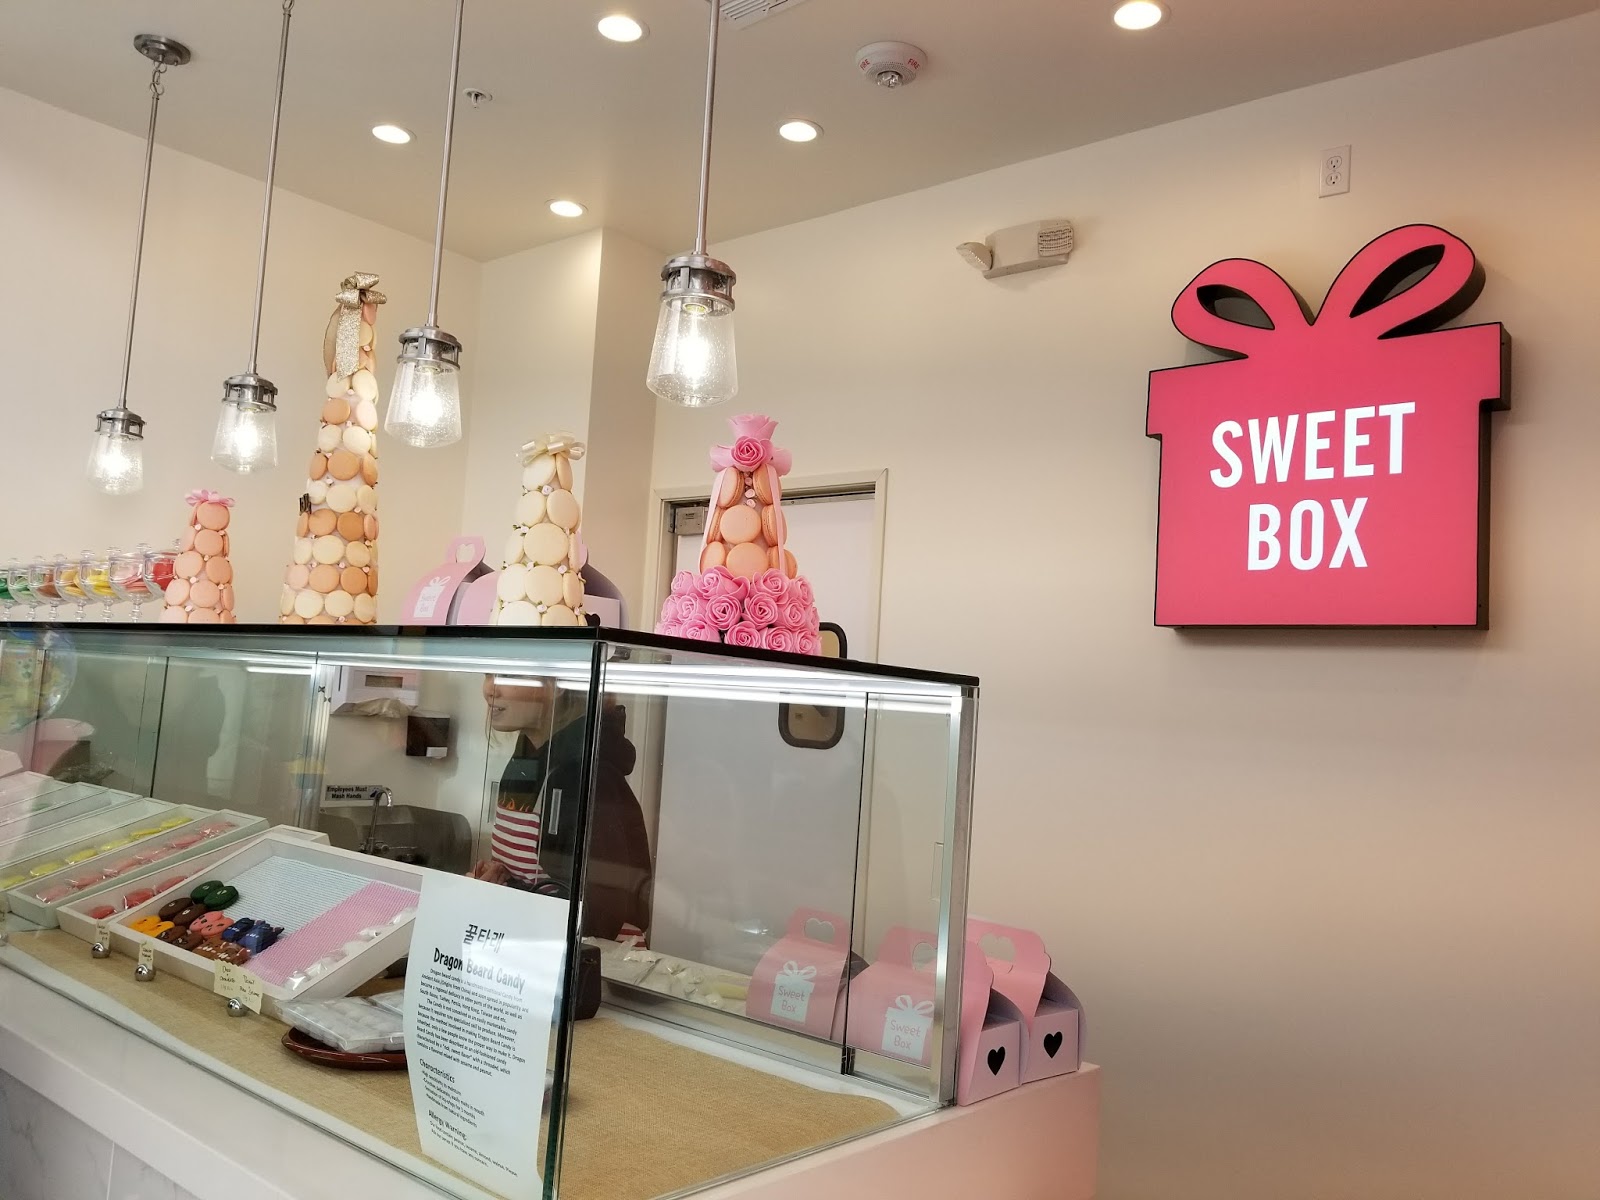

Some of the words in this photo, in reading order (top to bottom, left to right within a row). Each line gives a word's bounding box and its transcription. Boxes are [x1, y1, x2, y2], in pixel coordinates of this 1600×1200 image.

[907, 58, 921, 70] FIRE
[1209, 401, 1416, 489] SWEET
[1247, 497, 1368, 571] BOX
[326, 785, 354, 793] Employees
[463, 924, 505, 953] 꿀타래
[433, 947, 463, 971] Dragon
[466, 958, 494, 981] Beard
[496, 967, 526, 995] Candy
[778, 985, 806, 1002] Sweet
[781, 1000, 797, 1013] Box
[890, 1019, 922, 1037] Sweet
[894, 1035, 912, 1050] Box
[419, 1058, 455, 1083] Characteristics
[429, 1109, 444, 1127] Allergy
